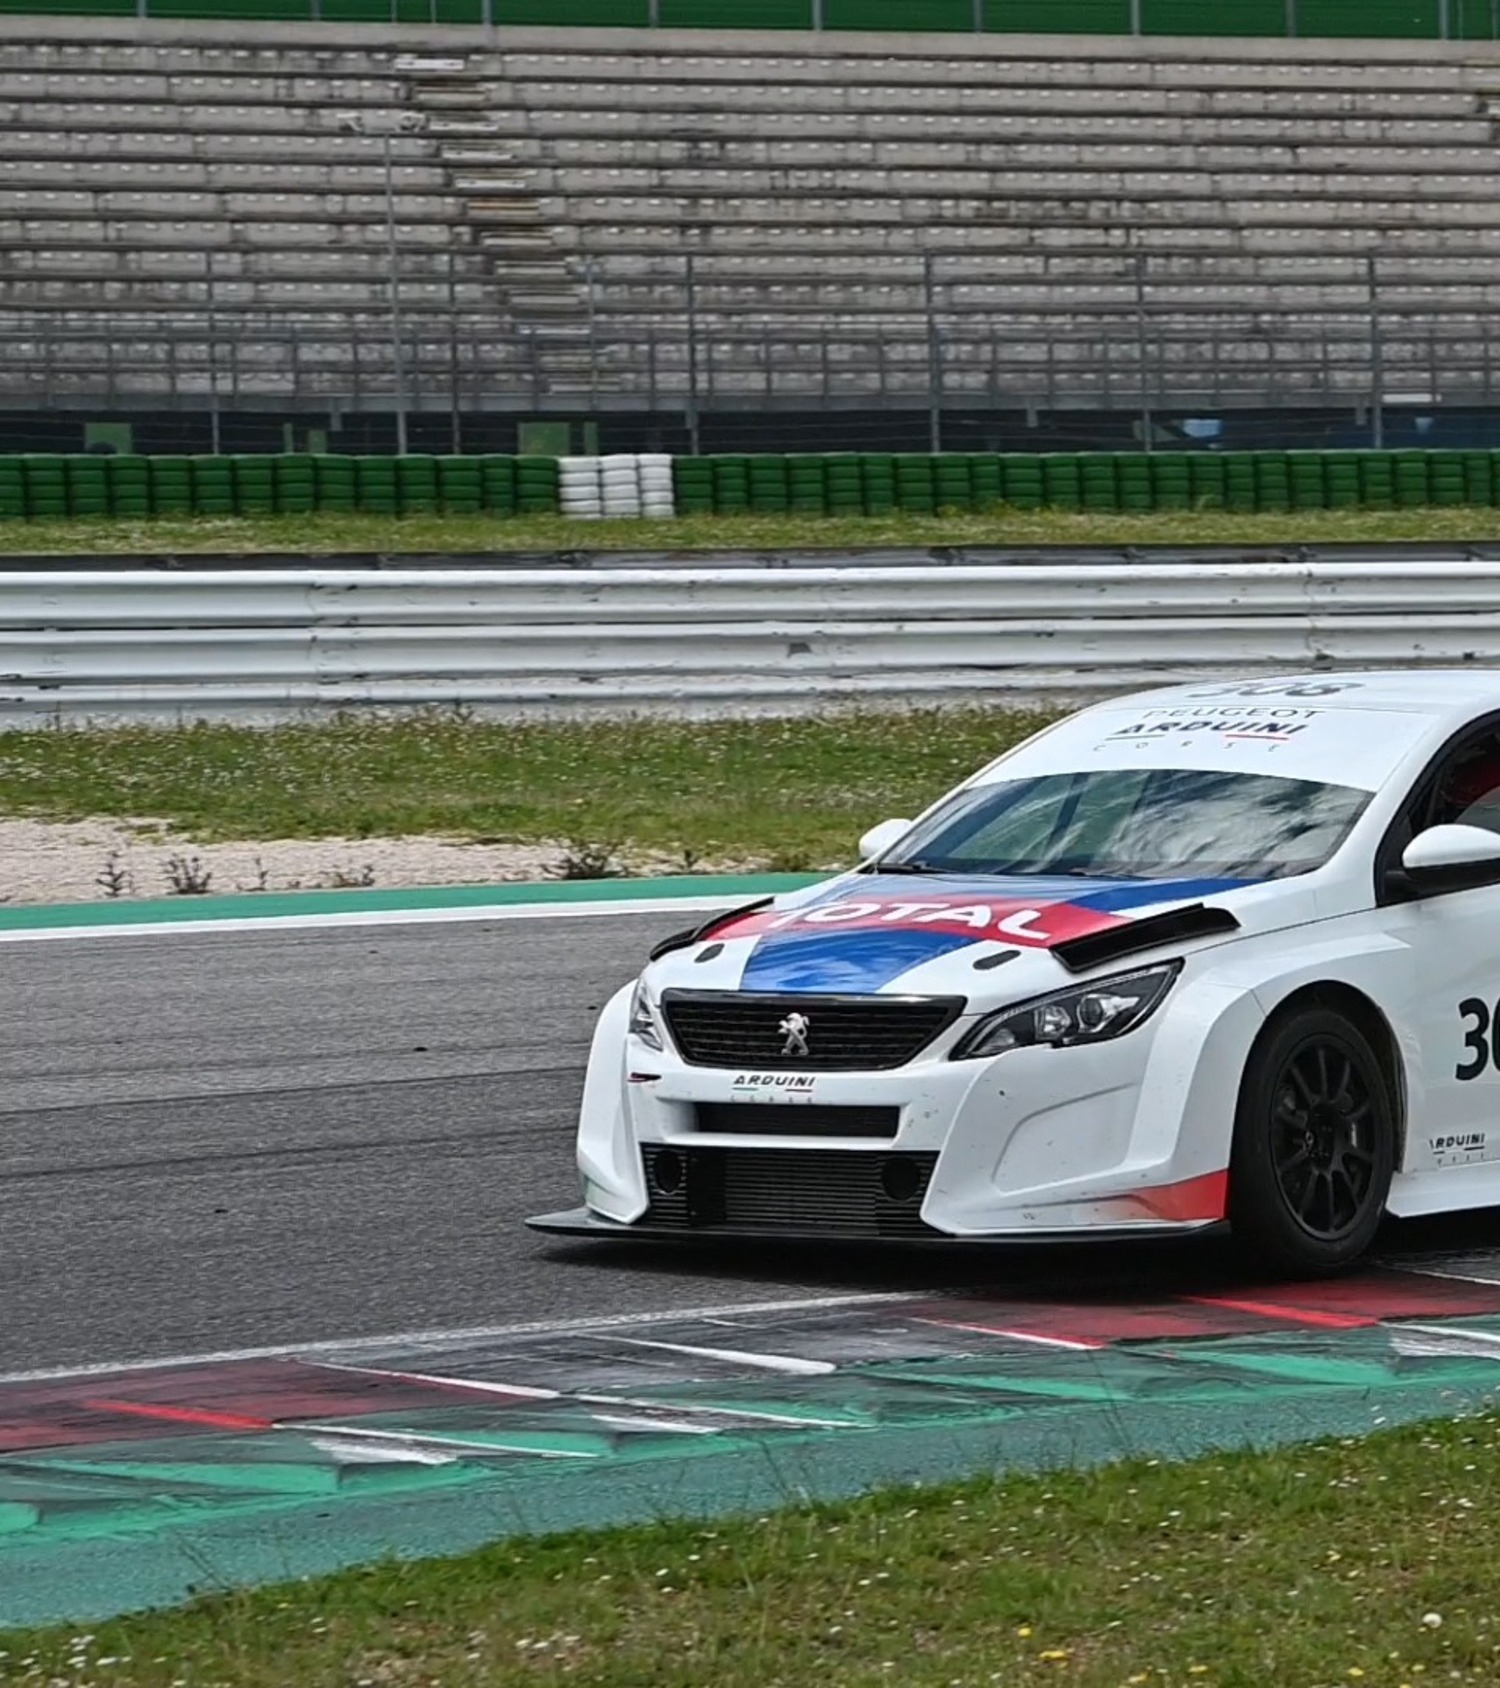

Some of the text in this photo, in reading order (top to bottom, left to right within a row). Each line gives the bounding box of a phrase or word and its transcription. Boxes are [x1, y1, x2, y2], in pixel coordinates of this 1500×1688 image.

[1143, 707, 1325, 720] PEUGEOT
[1114, 721, 1310, 735] ARDUINI
[768, 901, 1051, 939] TOTAL
[733, 1075, 816, 1087] ARDUINI
